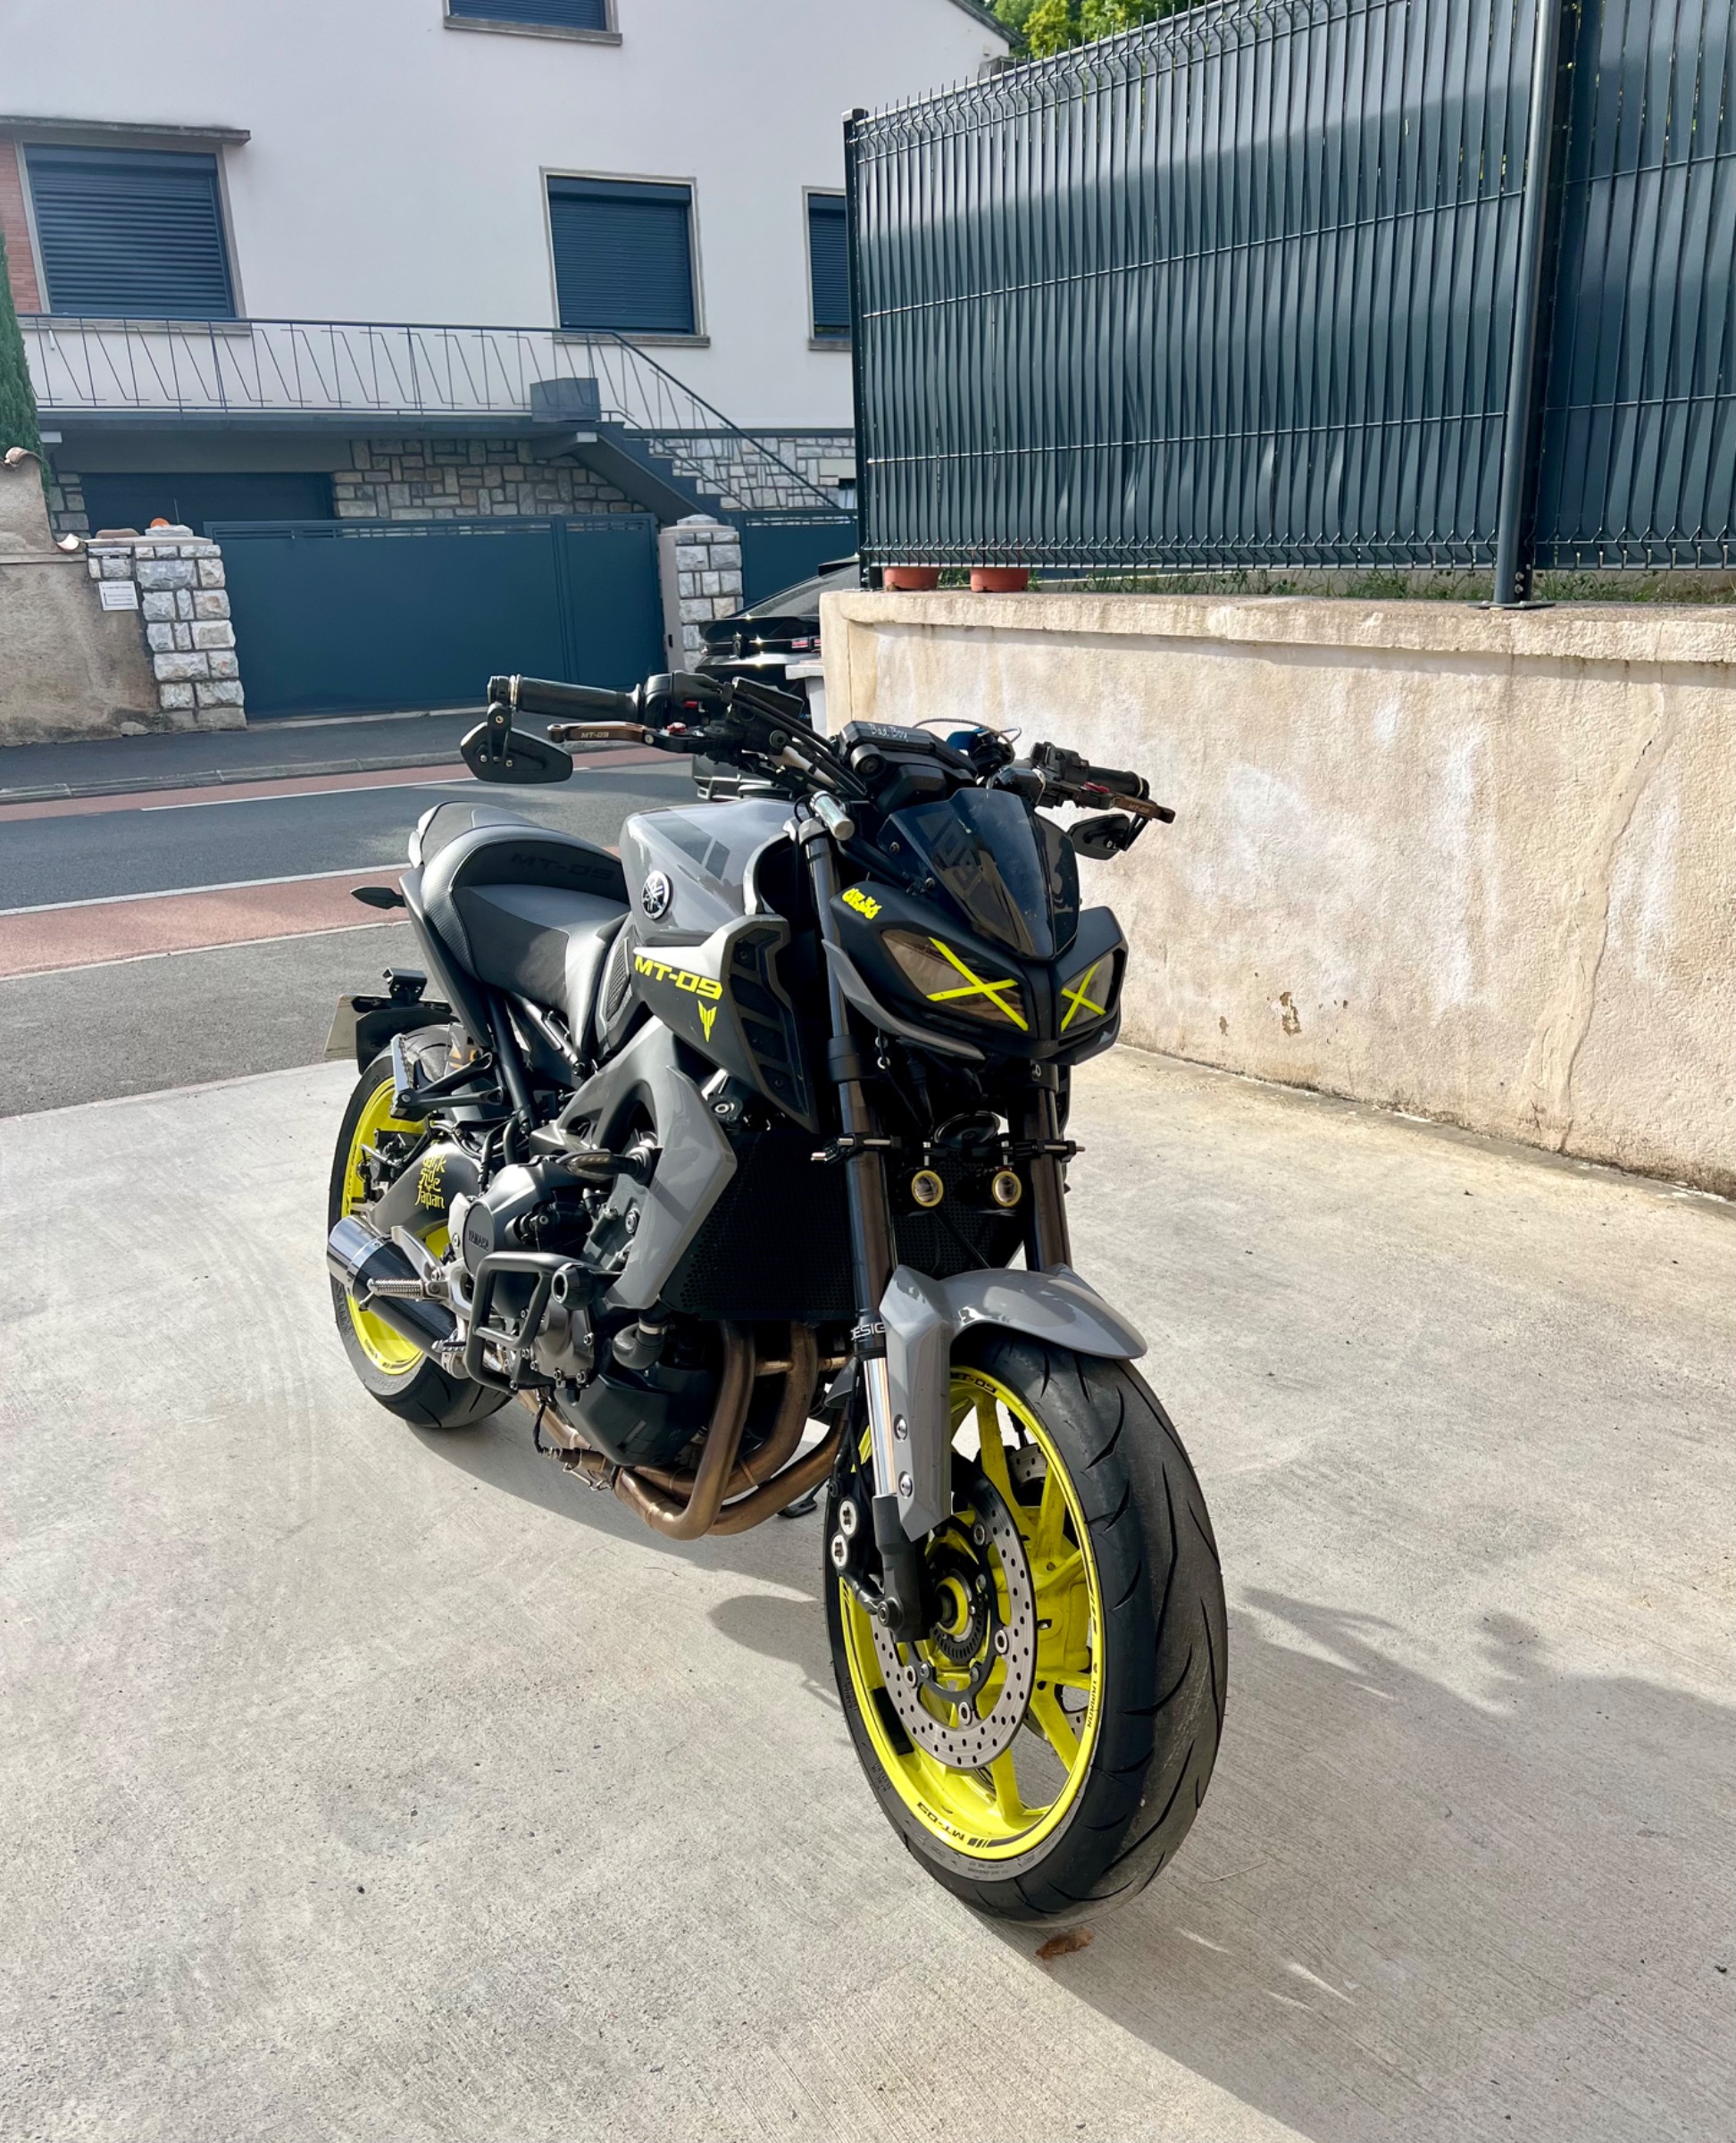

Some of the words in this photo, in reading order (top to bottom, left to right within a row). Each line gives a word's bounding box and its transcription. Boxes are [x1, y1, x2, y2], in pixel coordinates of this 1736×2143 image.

[580, 731, 610, 739] MT-09
[510, 853, 616, 880] MT-09
[634, 955, 723, 1001] MT-09
[414, 1186, 446, 1210] Japan
[916, 1801, 965, 1842] MT-09
